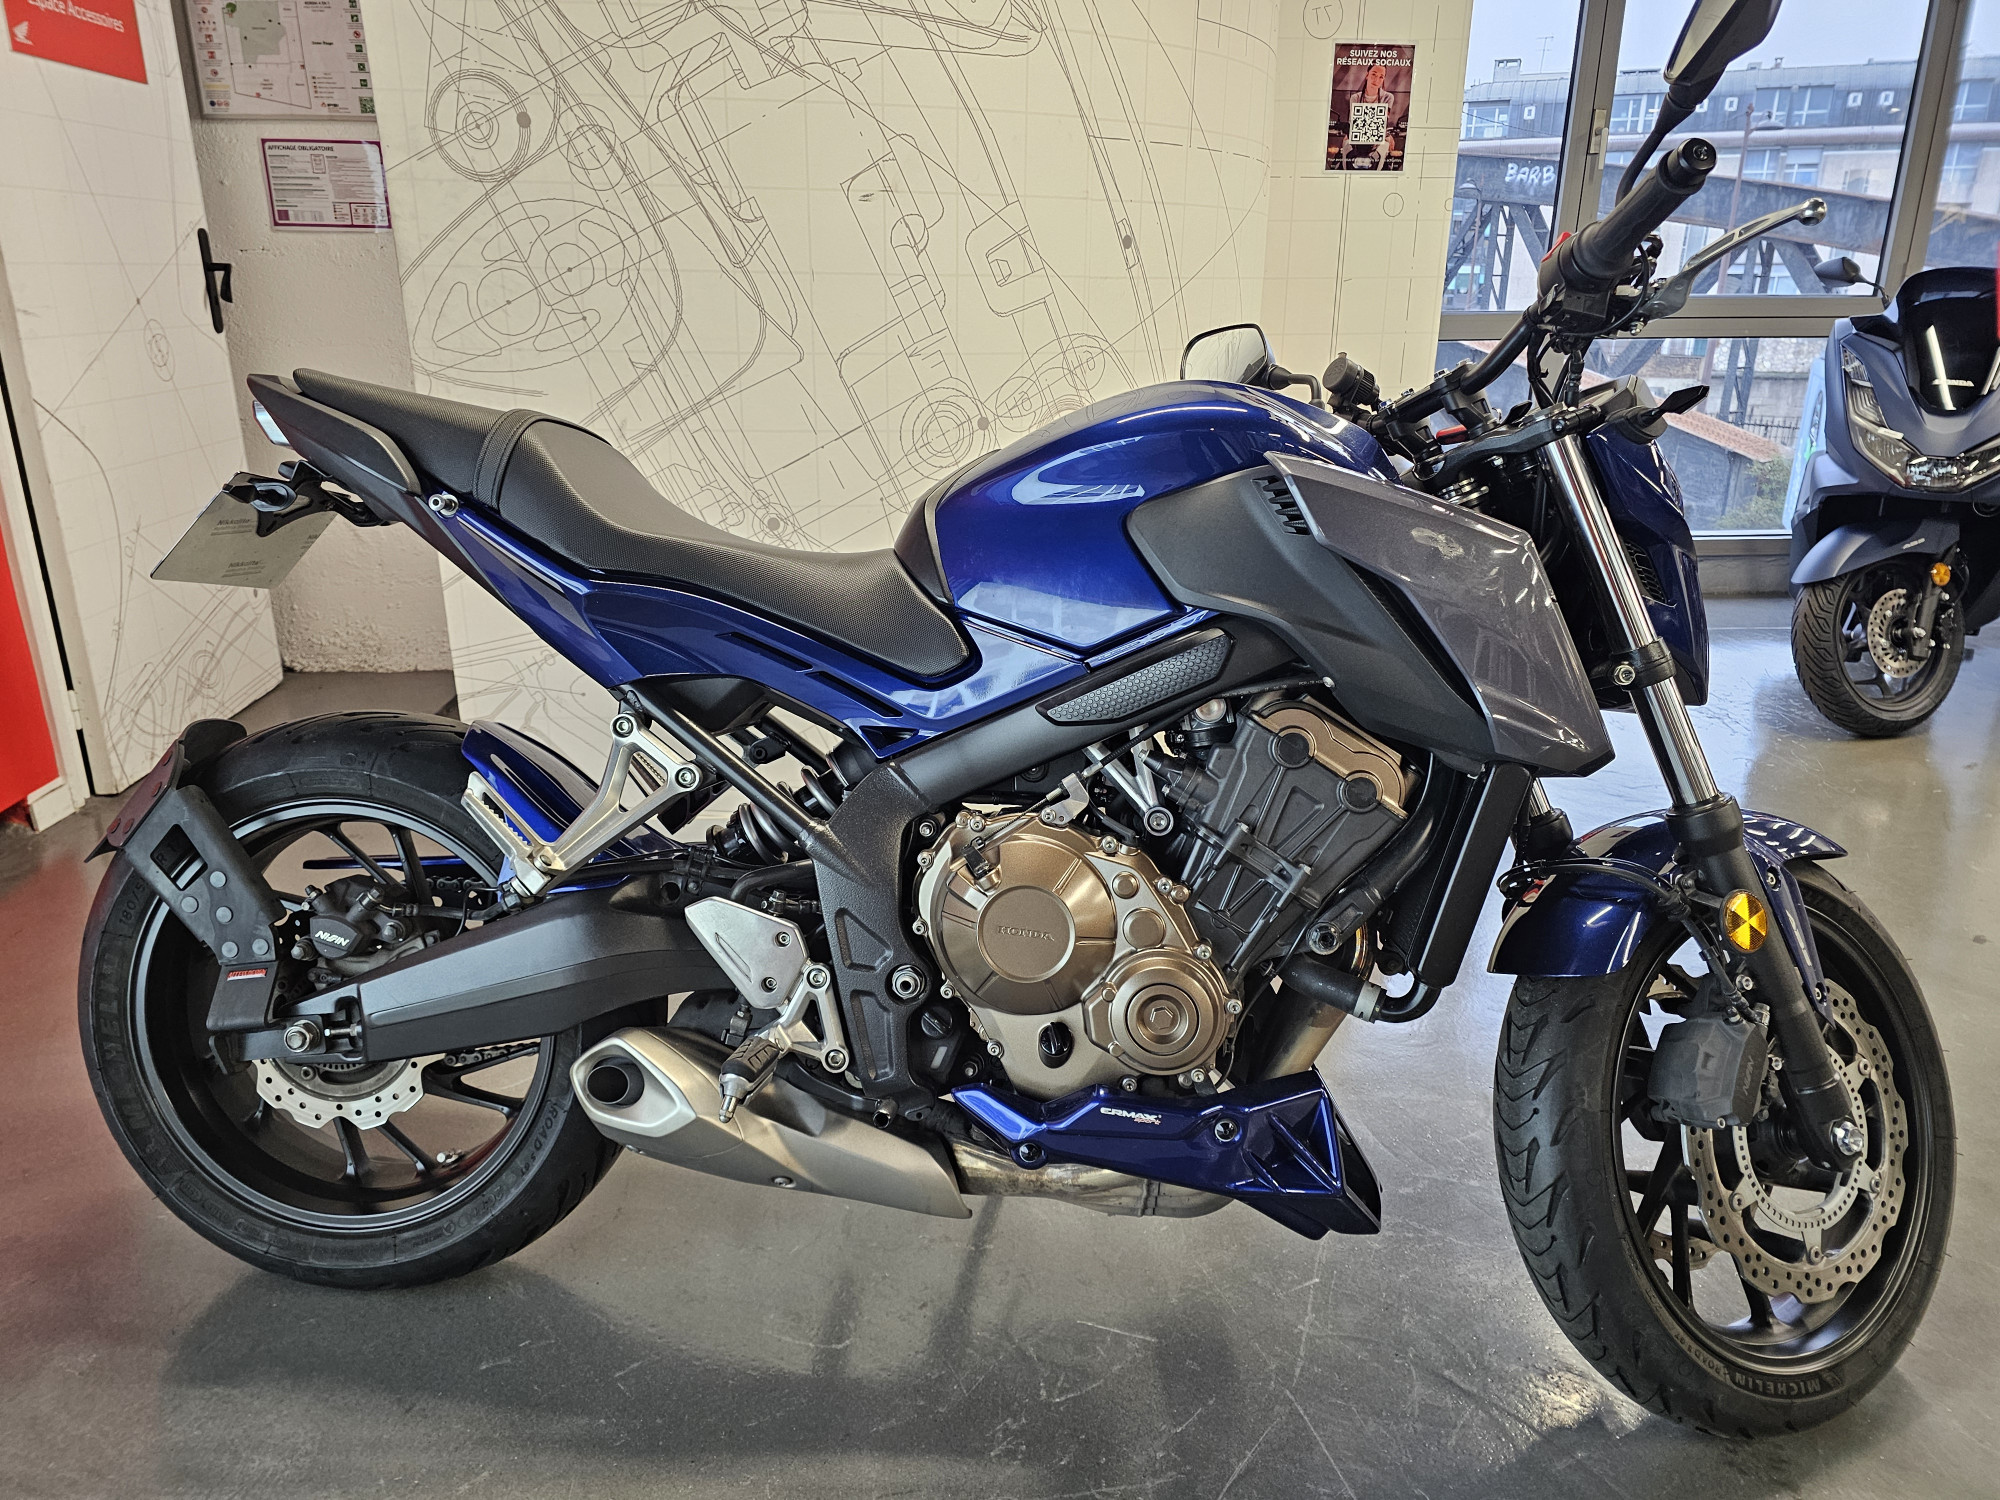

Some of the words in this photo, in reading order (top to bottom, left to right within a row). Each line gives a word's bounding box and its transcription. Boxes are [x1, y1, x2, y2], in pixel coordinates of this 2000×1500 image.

[27, 0, 66, 14] pace
[68, 0, 124, 32] Accessoires
[1349, 49, 1379, 58] SUIVEZ
[1380, 50, 1398, 58] NOS
[1336, 56, 1374, 66] RÉSEAUX
[1375, 58, 1411, 67] SOCIAUX
[997, 925, 1055, 941] HONDA
[1100, 1106, 1158, 1121] ERMAX
[1734, 1371, 1821, 1396] MICHELIN
